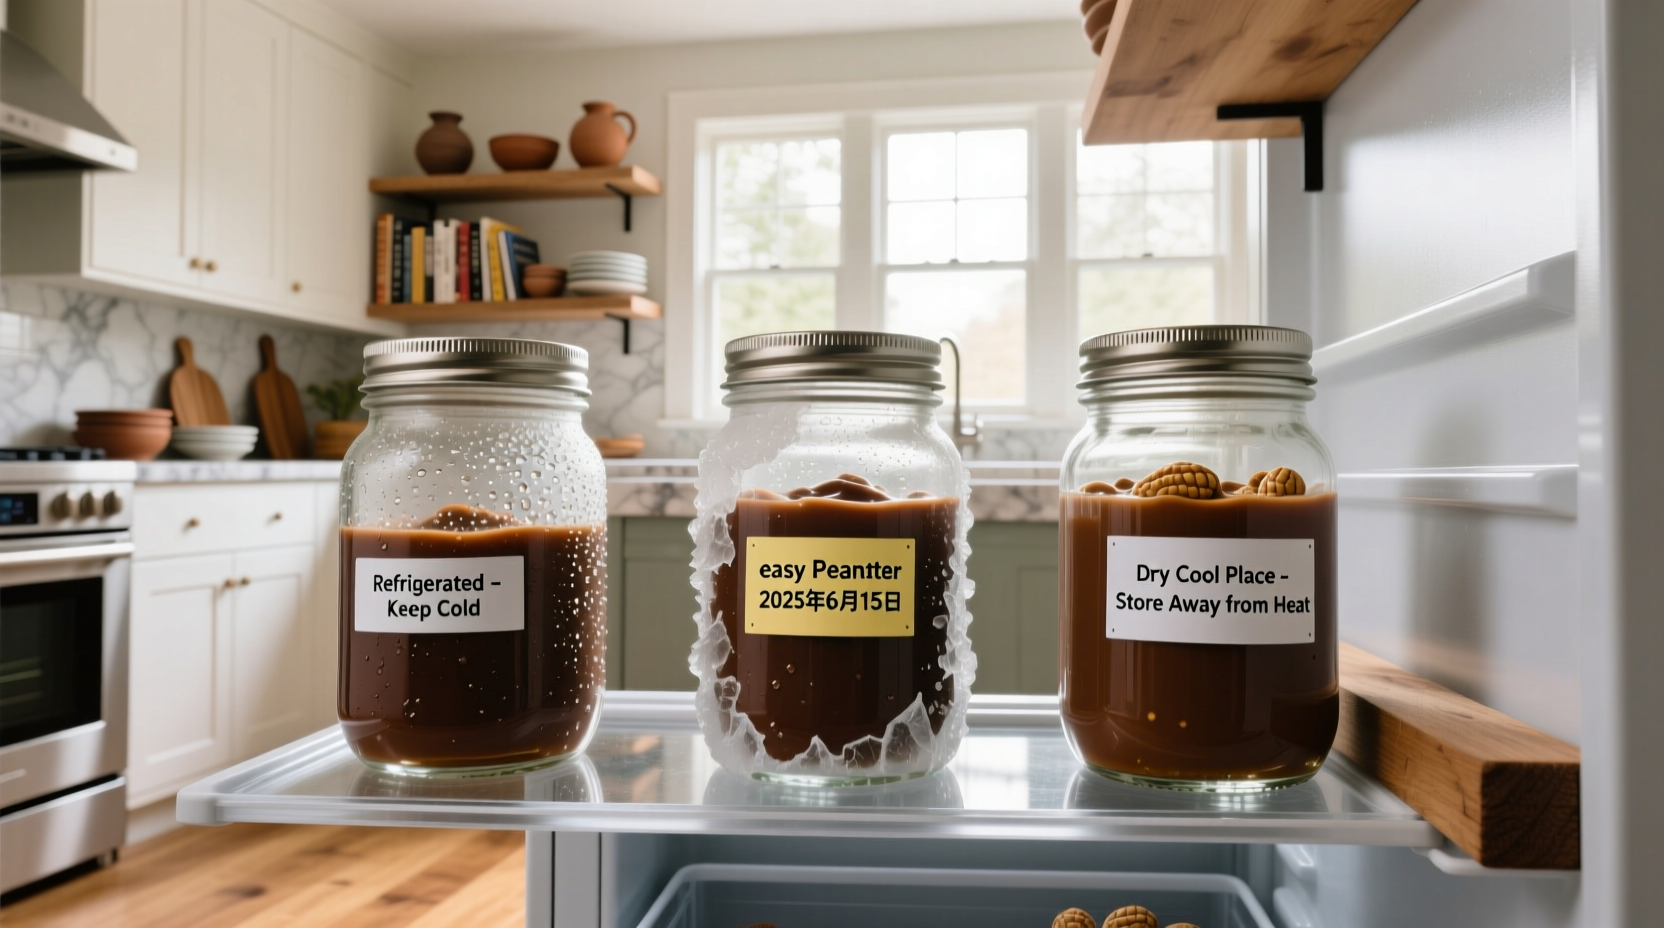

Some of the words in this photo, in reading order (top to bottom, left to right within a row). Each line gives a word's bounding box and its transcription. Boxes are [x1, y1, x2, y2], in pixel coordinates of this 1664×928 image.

[373, 573, 484, 597] Refrigerated
[759, 563, 806, 584] easy
[1137, 564, 1170, 588] Dry
[1176, 565, 1219, 584] Cool
[1226, 565, 1276, 584] Place
[387, 599, 432, 622] Keep
[437, 598, 480, 617] Cold
[759, 588, 901, 613] 2025年6月15日
[1116, 592, 1164, 612] Store
[1168, 594, 1221, 619] Away
[1225, 594, 1268, 614] from
[1274, 596, 1311, 614] Heat
